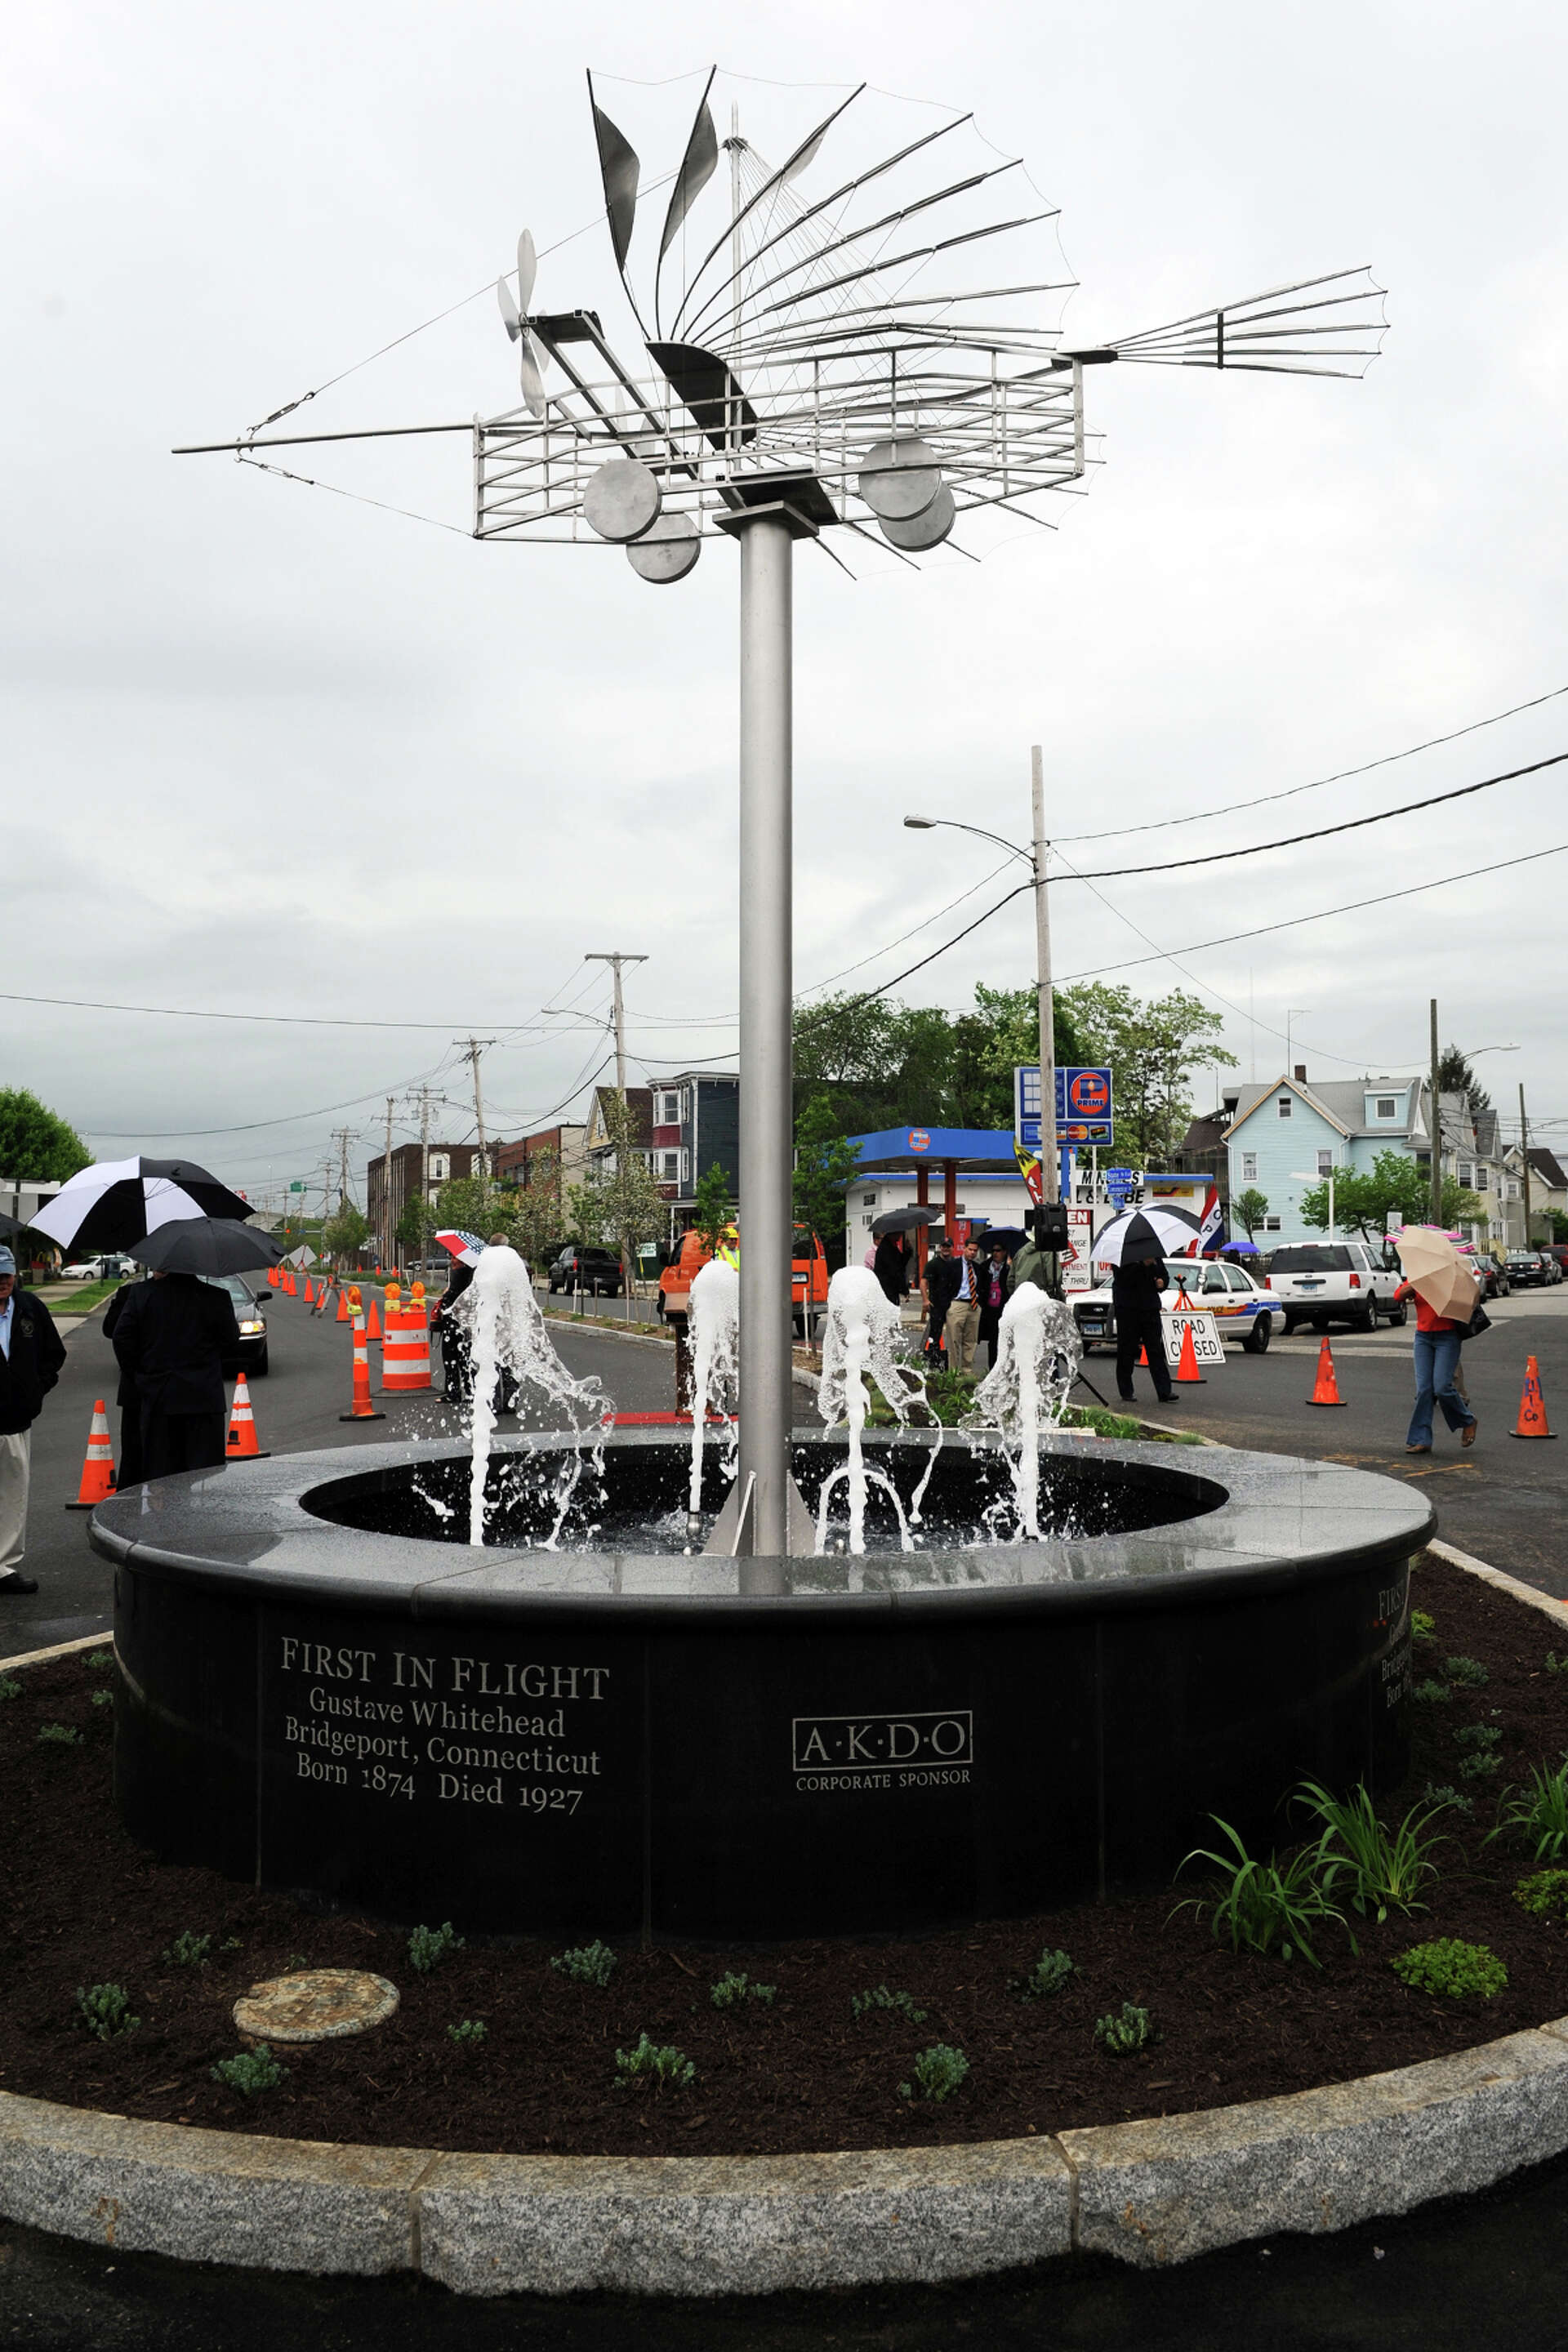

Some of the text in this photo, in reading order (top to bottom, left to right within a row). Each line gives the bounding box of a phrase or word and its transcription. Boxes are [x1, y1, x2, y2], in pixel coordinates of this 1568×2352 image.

[1076, 1098, 1104, 1107] PRIME
[1104, 1189, 1145, 1204] LBE
[1172, 1319, 1205, 1334] ROAD
[1170, 1340, 1218, 1356] CSED
[281, 1636, 610, 1699] FIRST IN FLIGHT
[310, 1686, 565, 1738] Gustave Whitehead
[285, 1716, 601, 1775] Bridgeport, Connecticut
[296, 1752, 583, 1815] Born 1874 Died 1927
[796, 1770, 970, 1790] CORPORATE SPONSOR
